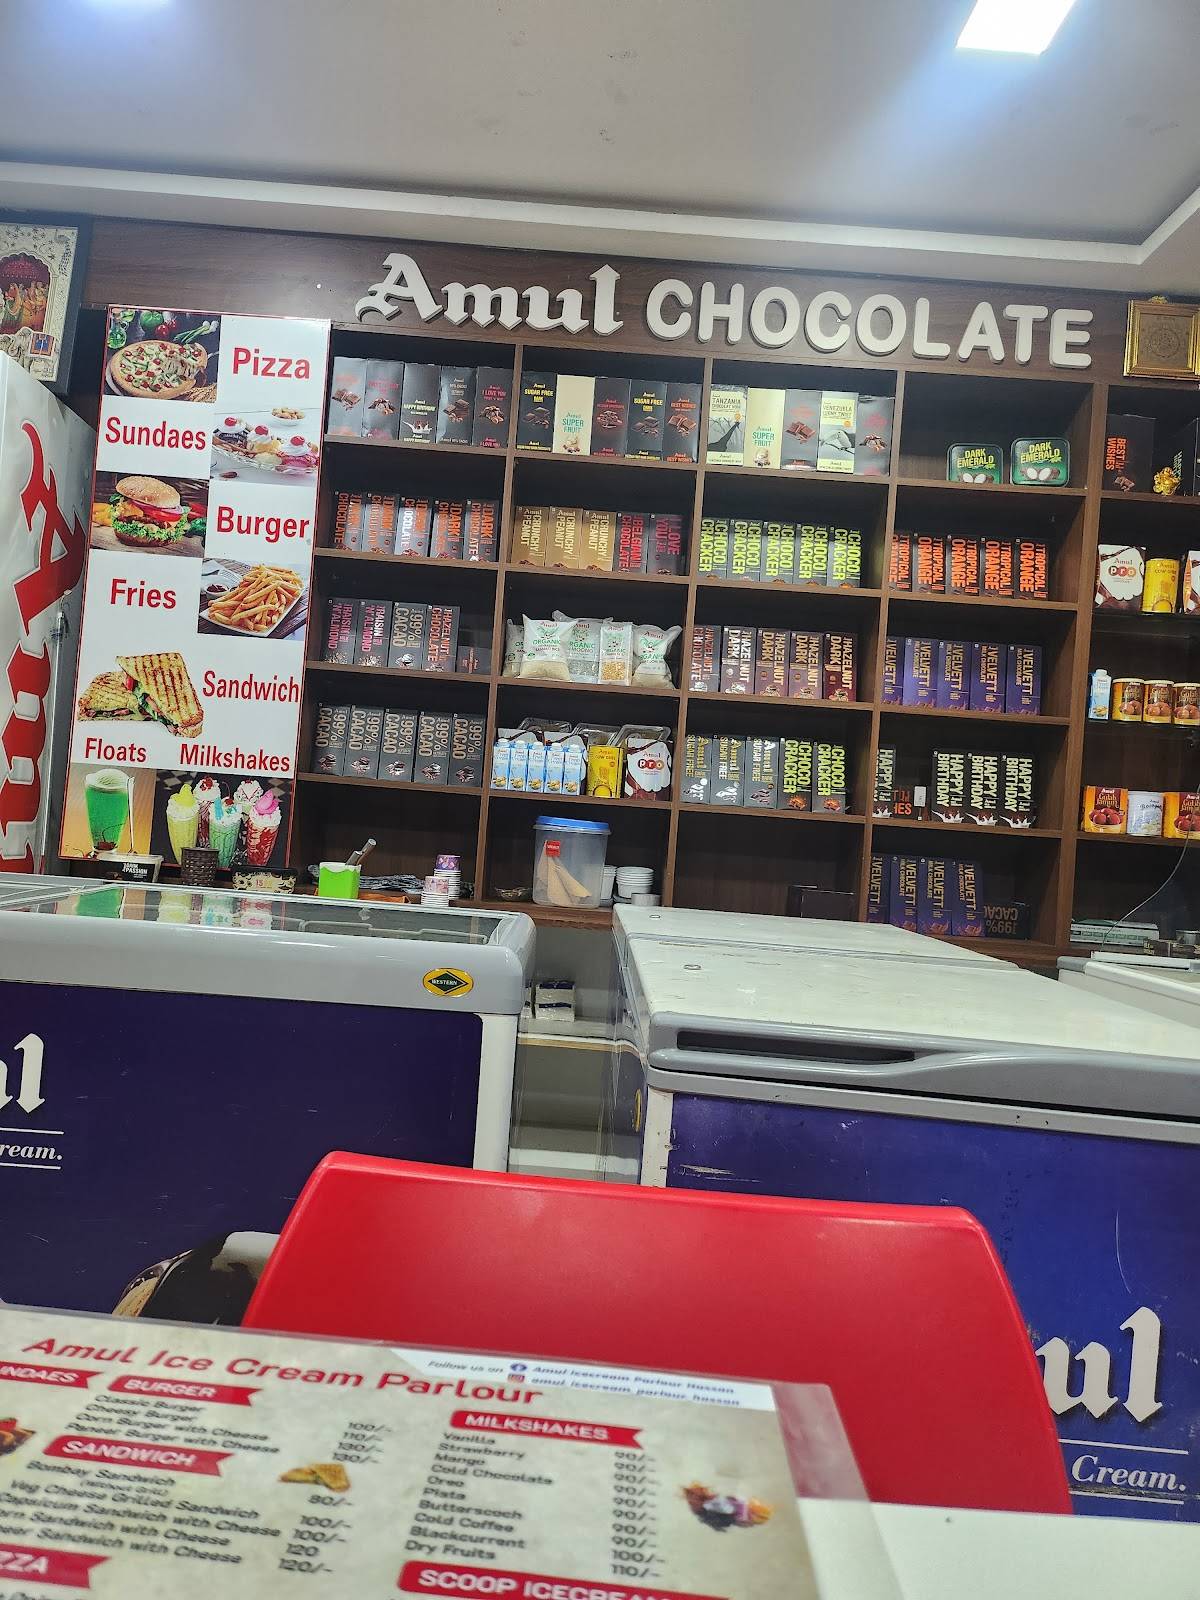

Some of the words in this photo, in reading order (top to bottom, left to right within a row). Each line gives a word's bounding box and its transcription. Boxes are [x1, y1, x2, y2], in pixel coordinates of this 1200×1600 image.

[354, 252, 624, 336] Amul
[645, 278, 1095, 369] CHOCOLATE
[232, 348, 310, 379] Pizza
[106, 416, 206, 450] Sundaes
[562, 418, 584, 426] SUPER
[752, 431, 775, 440] SUPER
[957, 456, 994, 468] EMERALD
[964, 448, 986, 458] DARK
[1020, 449, 1060, 464] EMERALD
[1029, 441, 1052, 453] DARK
[1106, 438, 1116, 470] WISHES
[1117, 438, 1126, 460] BEST
[216, 506, 310, 544] Burger
[334, 493, 349, 544] CHOCOLATE
[400, 499, 415, 548] CHOCOLATE
[449, 508, 461, 537] DARK
[481, 508, 494, 538] DARK
[520, 515, 531, 546] PEANUT
[530, 515, 542, 552] CRUNCHY
[588, 518, 599, 550] PEANUT
[597, 519, 609, 557] CRUNCHY
[619, 515, 632, 568] CHOCOLATE
[699, 519, 714, 572] CRACKER
[713, 524, 729, 564] CHOCO
[732, 521, 747, 575] CRACKER
[746, 525, 762, 566] CHOCO
[832, 528, 848, 581] CRACKER
[847, 533, 861, 573] CHOCO
[898, 538, 910, 580] TROPICAL
[918, 536, 932, 585] ORANGE
[932, 541, 944, 583] TROPICAL
[951, 539, 966, 588] ORANGE
[966, 543, 978, 586] TROPICAL
[1020, 542, 1035, 592] ORANGE
[1035, 548, 1046, 590] TROPICAL
[110, 578, 177, 610] Fries
[361, 618, 374, 652] ALMOND
[392, 608, 410, 646] CACAO
[409, 614, 424, 640] 99%
[427, 607, 441, 662] CHOCOLATE
[727, 630, 740, 658] DARK
[739, 634, 752, 682] HAZELNUT
[761, 632, 774, 661] DARK
[773, 636, 785, 685] HAZELNUT
[829, 636, 841, 664] DARK
[841, 641, 852, 689] HAZELNUT
[884, 643, 897, 685] VELVETT
[919, 644, 931, 687] VELVETT
[951, 648, 964, 690] VELVETT
[986, 649, 998, 692] VELVETT
[1022, 652, 1034, 695] VELVETT
[202, 670, 300, 703] Sandwich
[315, 708, 332, 747] CACAO
[331, 714, 347, 741] 99%
[349, 711, 366, 750] CACAO
[364, 717, 380, 744] 99%
[452, 719, 469, 760] CACAO
[468, 725, 482, 753] 99%
[85, 737, 147, 763] Floats
[180, 743, 290, 772] Milkshakes
[638, 760, 664, 769] pro
[817, 744, 831, 796] CRACKER
[832, 749, 845, 792] CHOCO
[937, 752, 950, 808] BIRTHDAY
[950, 754, 964, 798] HAPPY
[1005, 757, 1018, 812] BIRTHDAY
[1018, 758, 1033, 802] HAPPY
[125, 867, 148, 875] PASSION
[22, 1338, 139, 1363] Amul
[148, 1350, 213, 1371] Ice
[226, 1357, 364, 1388] Cream
[377, 1372, 544, 1405] Parlour
[123, 1379, 216, 1398] BURGER
[144, 1410, 200, 1422] Burger
[154, 1401, 208, 1413] Burger
[65, 1422, 122, 1436] Paneer
[124, 1429, 180, 1442] Burger
[183, 1436, 218, 1446] with
[221, 1441, 280, 1453] Cheese
[116, 1418, 171, 1430] Burger
[175, 1424, 208, 1434] with
[212, 1428, 269, 1440] Cheese
[443, 1432, 496, 1445] Vanilla
[464, 1414, 609, 1440] MILKSHAKES
[62, 1440, 197, 1465] SANDWICH
[433, 1453, 485, 1467] Mango
[438, 1442, 526, 1460] Strawberry
[95, 1469, 176, 1486] Sandwich
[426, 1475, 465, 1488] Oreo
[430, 1464, 467, 1476] Cold
[472, 1468, 554, 1486] Chocolate
[1071, 1454, 1186, 1491] Cream.
[175, 1500, 260, 1519] Sandwich
[422, 1487, 466, 1501] Pista
[29, 1512, 116, 1531] Sandwich
[120, 1524, 160, 1536] with
[164, 1528, 231, 1546] Cheese
[83, 1503, 168, 1522] Sandwich
[172, 1516, 211, 1527] with
[215, 1520, 282, 1537] Cheese
[293, 1528, 346, 1543] 100/-
[413, 1512, 454, 1526] Cold
[459, 1517, 515, 1533] Coffee
[37, 1528, 125, 1548] Sandwich
[129, 1541, 170, 1554] with
[174, 1546, 242, 1563] Cheese
[285, 1543, 319, 1557] 120
[404, 1539, 437, 1554] Dry
[442, 1544, 496, 1560] Fruits
[278, 1558, 333, 1573] 120/-
[418, 1569, 518, 1593] SCOOP
